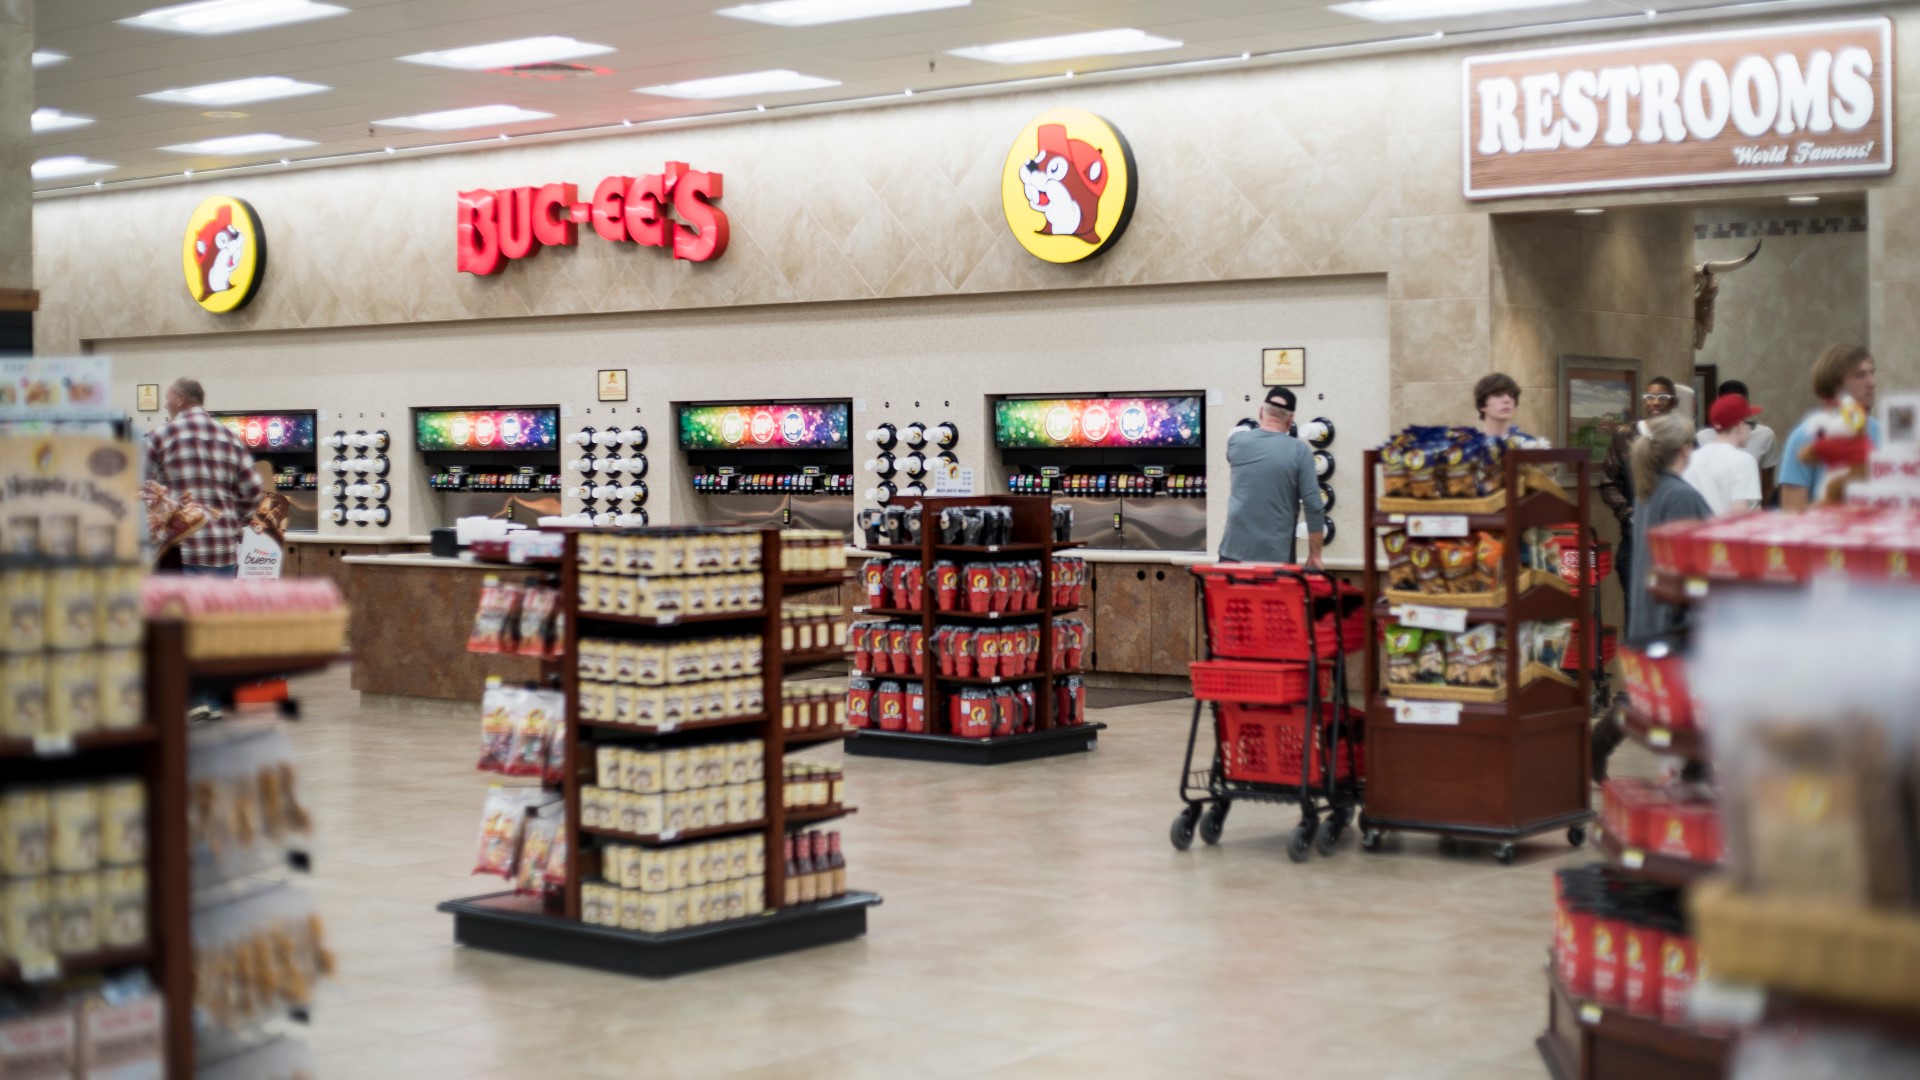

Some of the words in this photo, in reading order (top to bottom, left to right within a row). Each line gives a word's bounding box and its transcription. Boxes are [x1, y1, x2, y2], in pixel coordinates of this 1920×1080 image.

[1478, 47, 1874, 154] RESTROOMS
[1733, 144, 1789, 165] World
[1793, 140, 1875, 163] Famous!
[457, 160, 730, 276] BUC-EE'S
[244, 552, 276, 564] bueno
